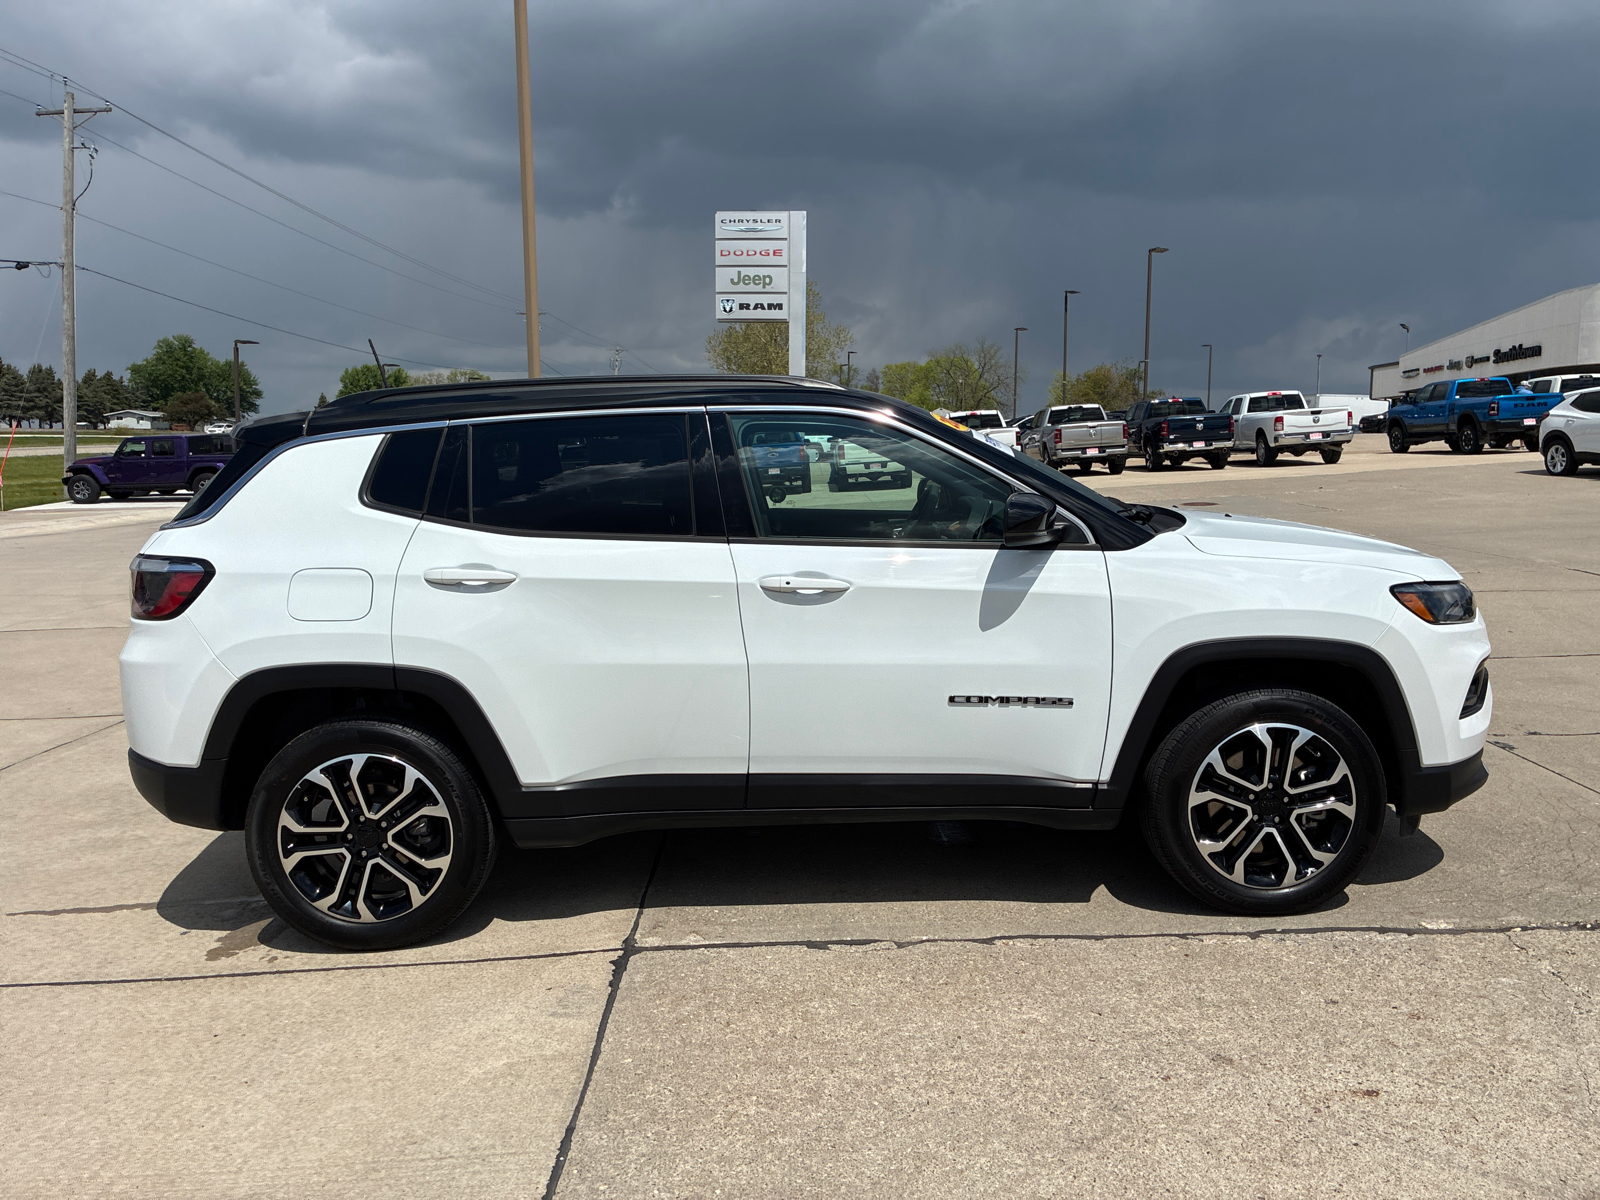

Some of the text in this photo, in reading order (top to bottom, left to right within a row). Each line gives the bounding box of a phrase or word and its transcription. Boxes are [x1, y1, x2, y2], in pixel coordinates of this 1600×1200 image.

[720, 249, 783, 257] DODGE
[730, 270, 773, 289] Jeep
[738, 302, 784, 311] RAM
[1492, 344, 1542, 364] Southtown
[947, 695, 1074, 708] COMPASS
